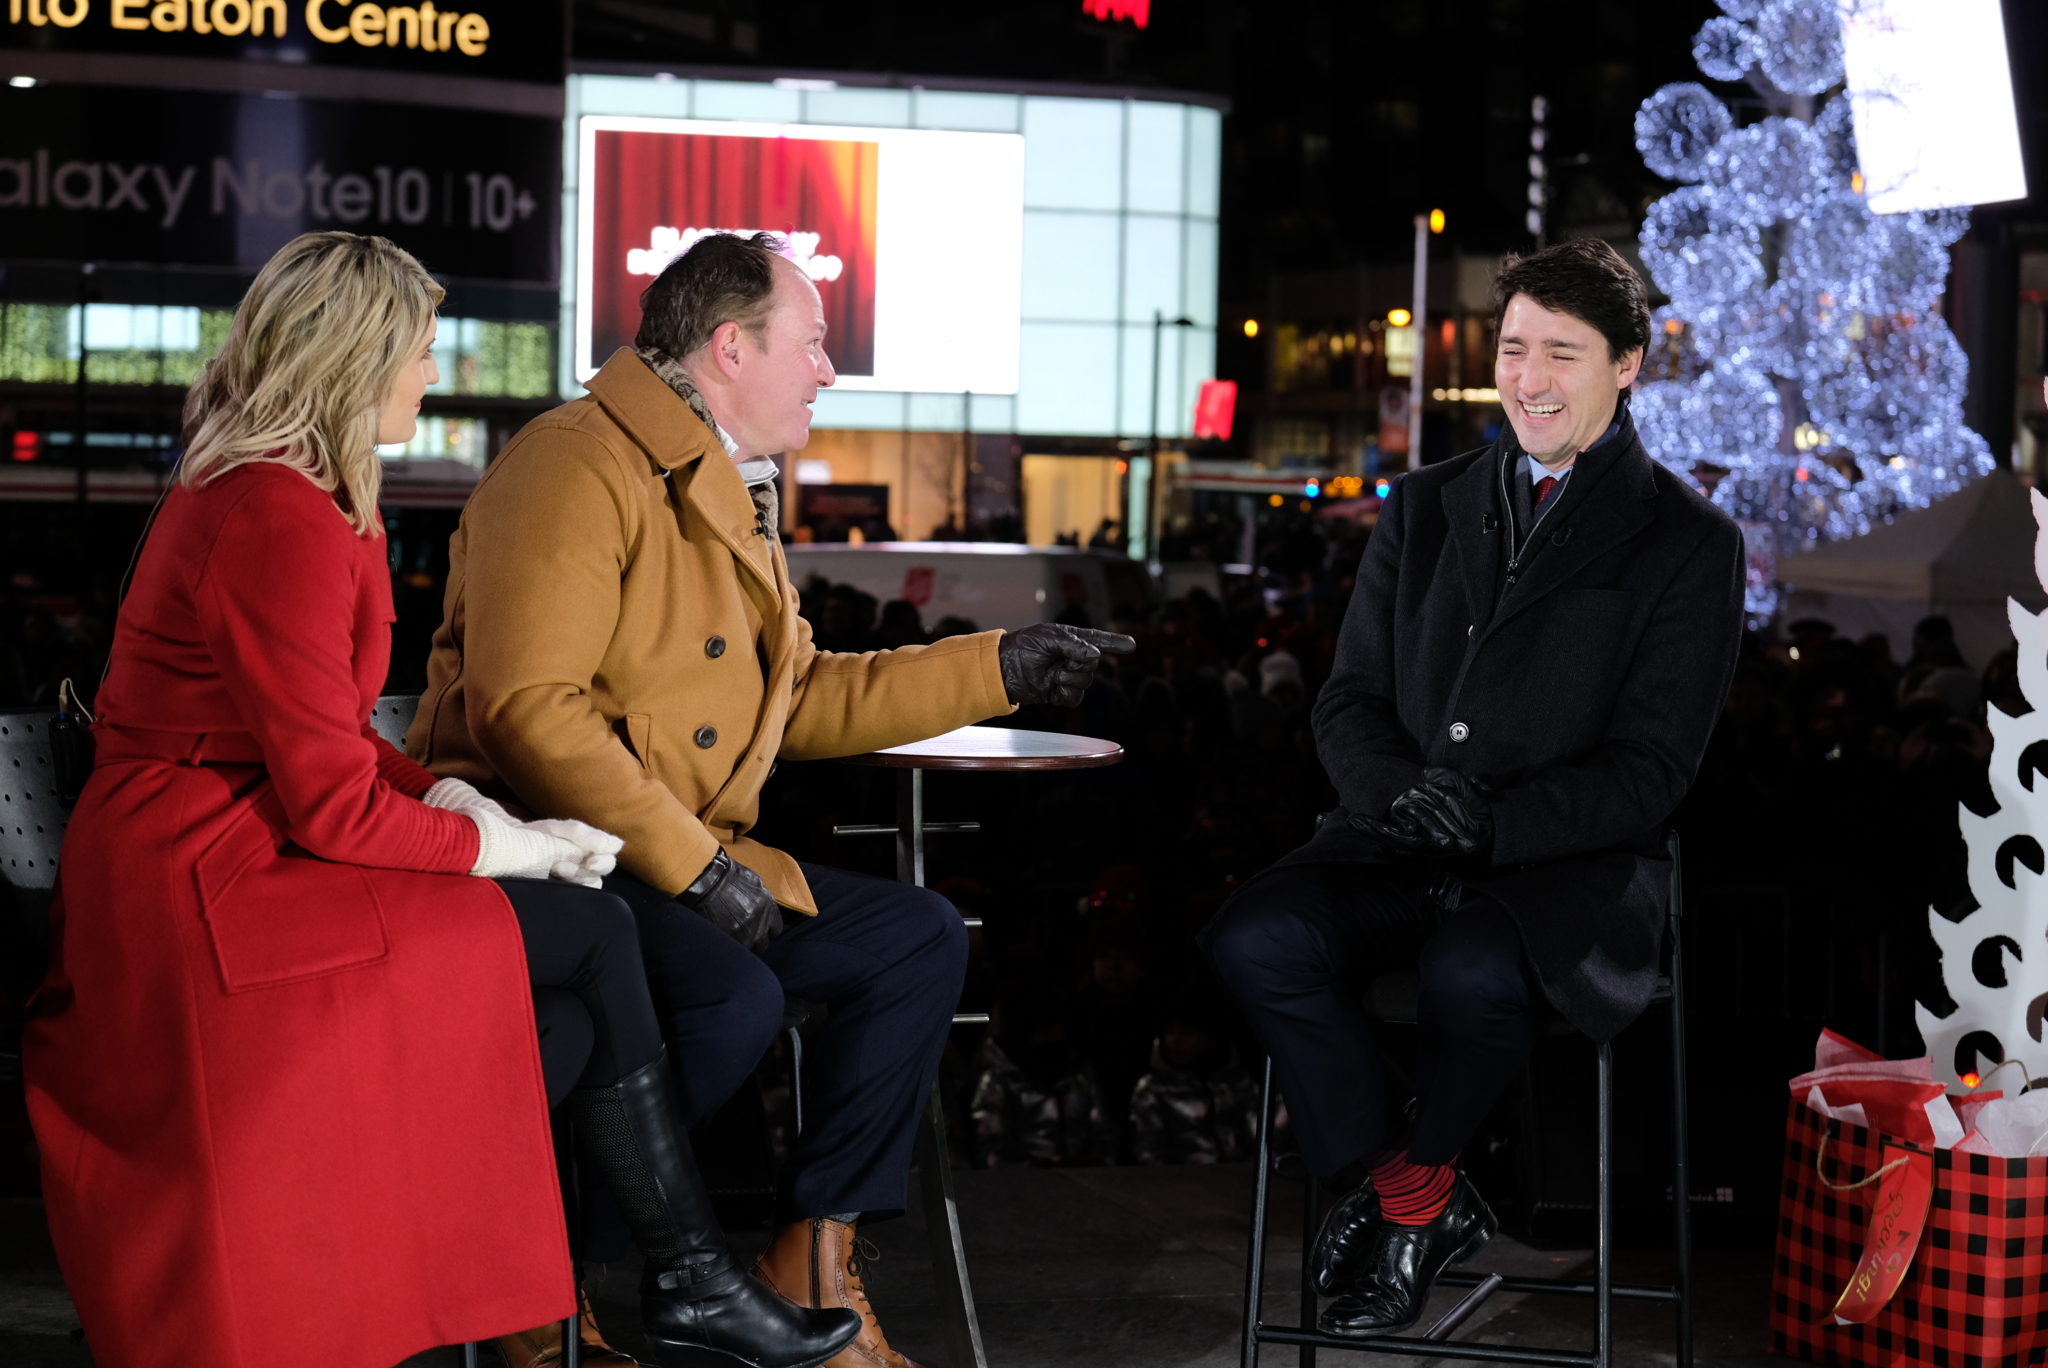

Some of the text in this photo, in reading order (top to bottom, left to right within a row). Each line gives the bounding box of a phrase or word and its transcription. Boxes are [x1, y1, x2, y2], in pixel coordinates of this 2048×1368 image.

[110, 0, 288, 38] Eaton
[305, 0, 490, 57] Centre
[0, 148, 535, 230] alaxy Note10 10+
[1885, 1230, 1911, 1273] NO
